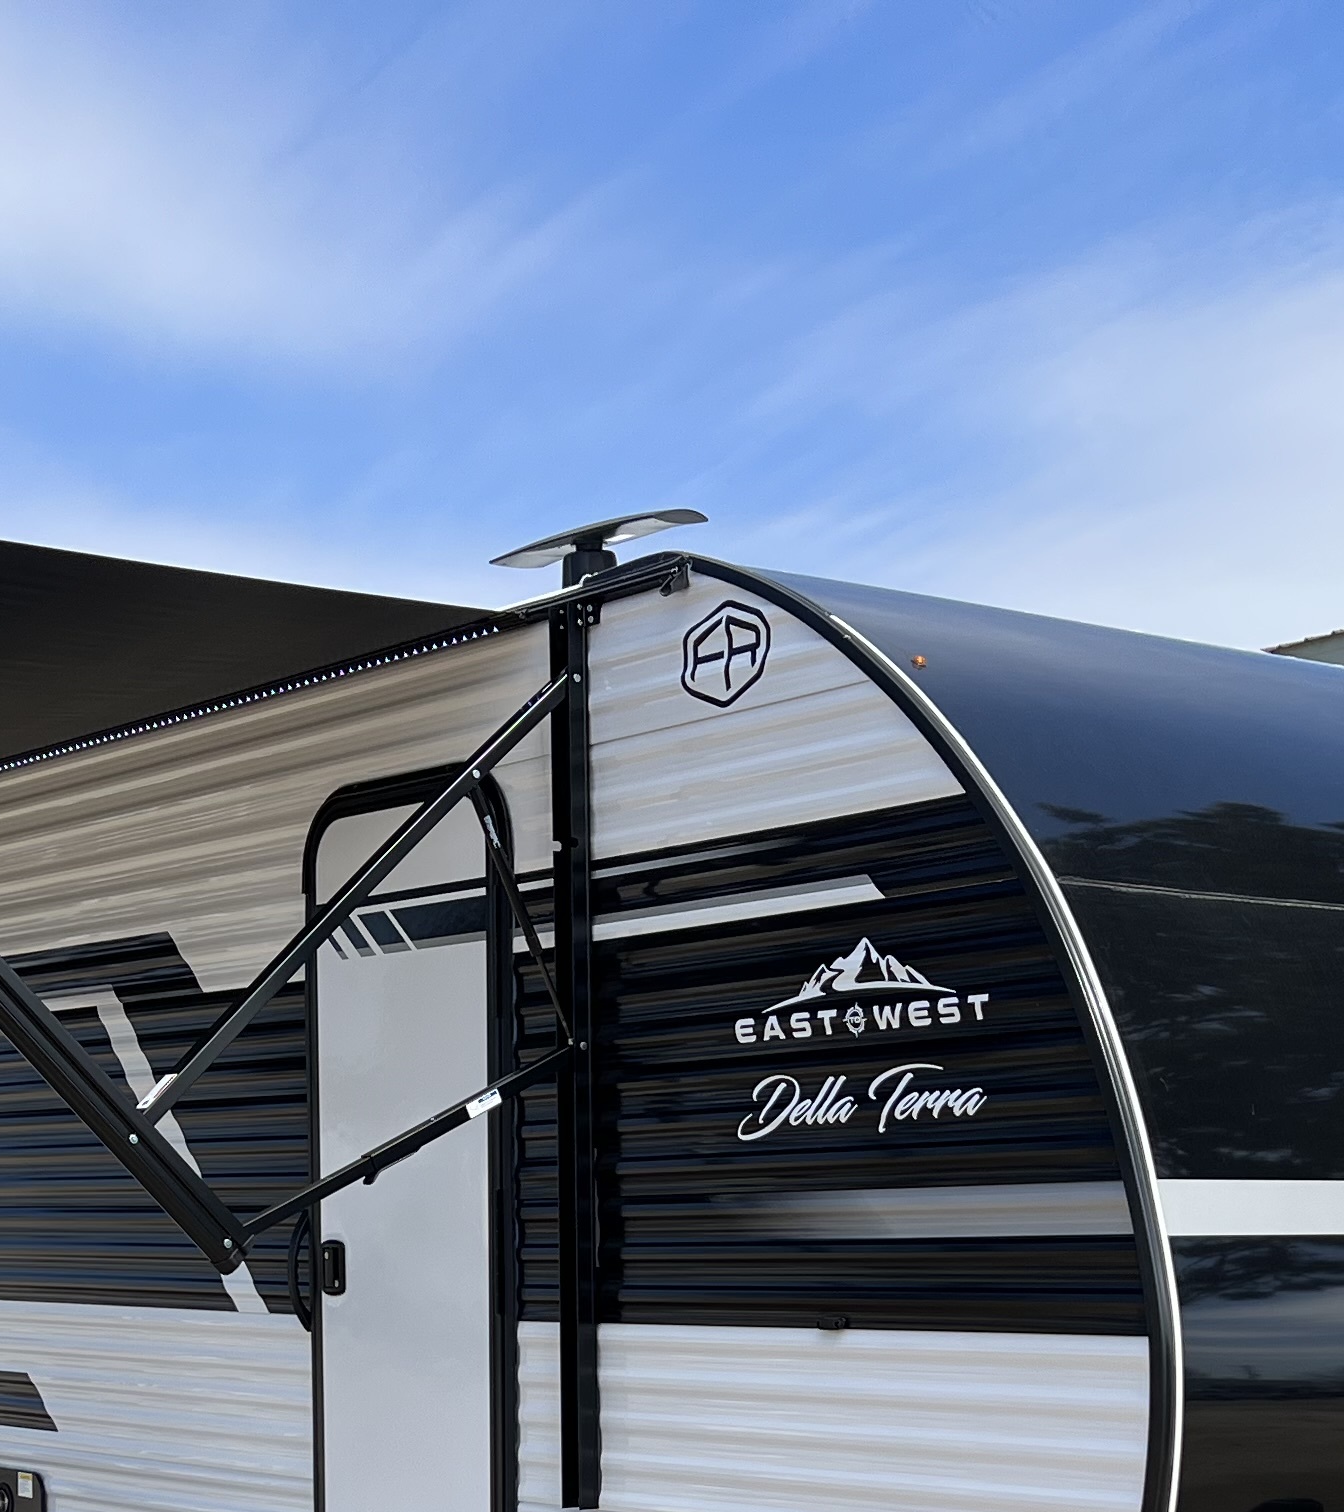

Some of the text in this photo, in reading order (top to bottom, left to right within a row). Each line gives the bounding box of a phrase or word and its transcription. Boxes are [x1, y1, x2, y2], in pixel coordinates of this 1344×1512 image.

[734, 1008, 838, 1044] EAST
[872, 993, 990, 1030] WEST
[737, 1063, 988, 1141] Della Terra
